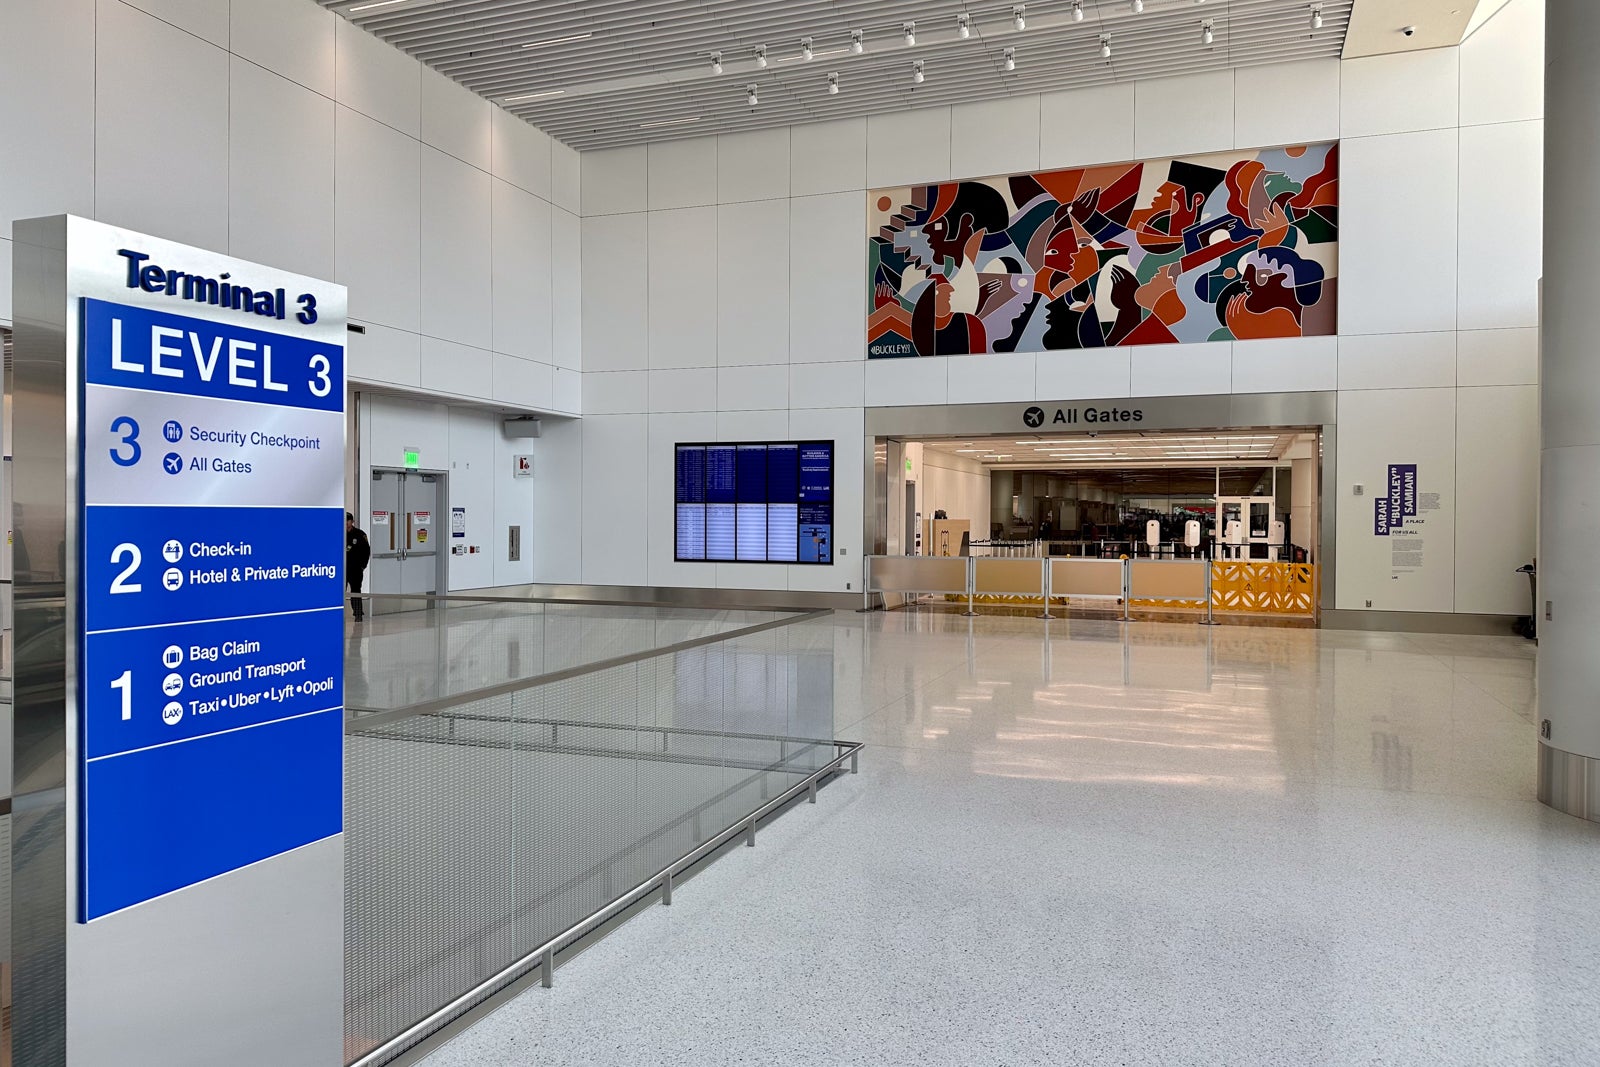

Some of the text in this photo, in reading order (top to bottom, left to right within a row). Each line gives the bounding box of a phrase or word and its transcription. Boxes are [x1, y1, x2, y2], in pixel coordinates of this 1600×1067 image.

[117, 248, 318, 325] Terminal 3
[111, 318, 332, 397] LEVEL 3
[1052, 407, 1143, 424] All Gates
[109, 416, 142, 467] 3
[189, 426, 321, 450] Security Checkpoint
[189, 456, 252, 474] All Gates
[1405, 472, 1414, 514] SAMIANI
[1378, 500, 1387, 533] SARAH
[189, 541, 252, 558] Check-in
[109, 542, 142, 594] 2
[189, 563, 336, 584] Hotel & Private Parking
[189, 640, 260, 661] Bag Claim
[189, 658, 306, 688] Ground Transport
[110, 670, 132, 721] 1
